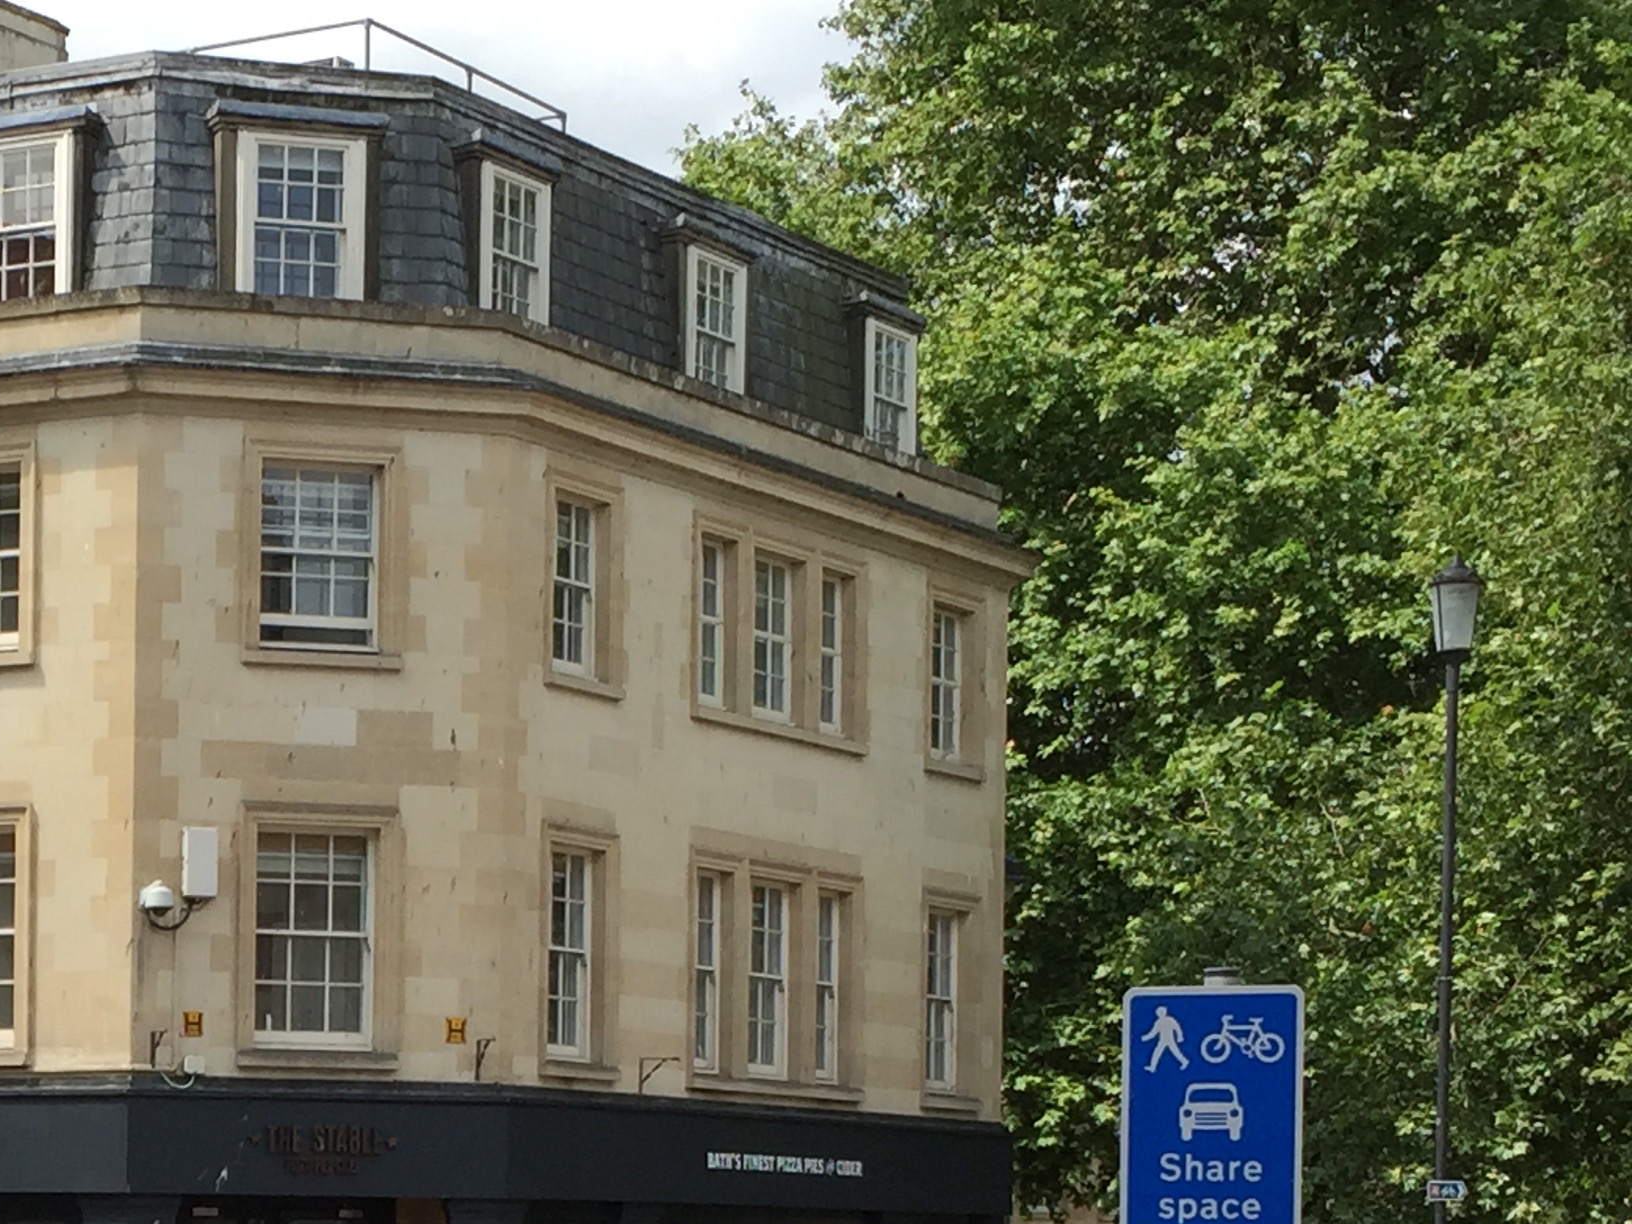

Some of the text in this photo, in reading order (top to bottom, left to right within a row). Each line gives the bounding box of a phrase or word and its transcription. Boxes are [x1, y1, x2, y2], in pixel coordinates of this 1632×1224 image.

[266, 1124, 303, 1154] THE
[706, 1152, 741, 1170] BATH'S
[743, 1154, 775, 1171] FINEST
[776, 1156, 802, 1173] PIZZA
[804, 1158, 824, 1174] PIES
[836, 1160, 864, 1177] CIDER
[1159, 1153, 1263, 1182] Share
[1158, 1197, 1262, 1224] space
